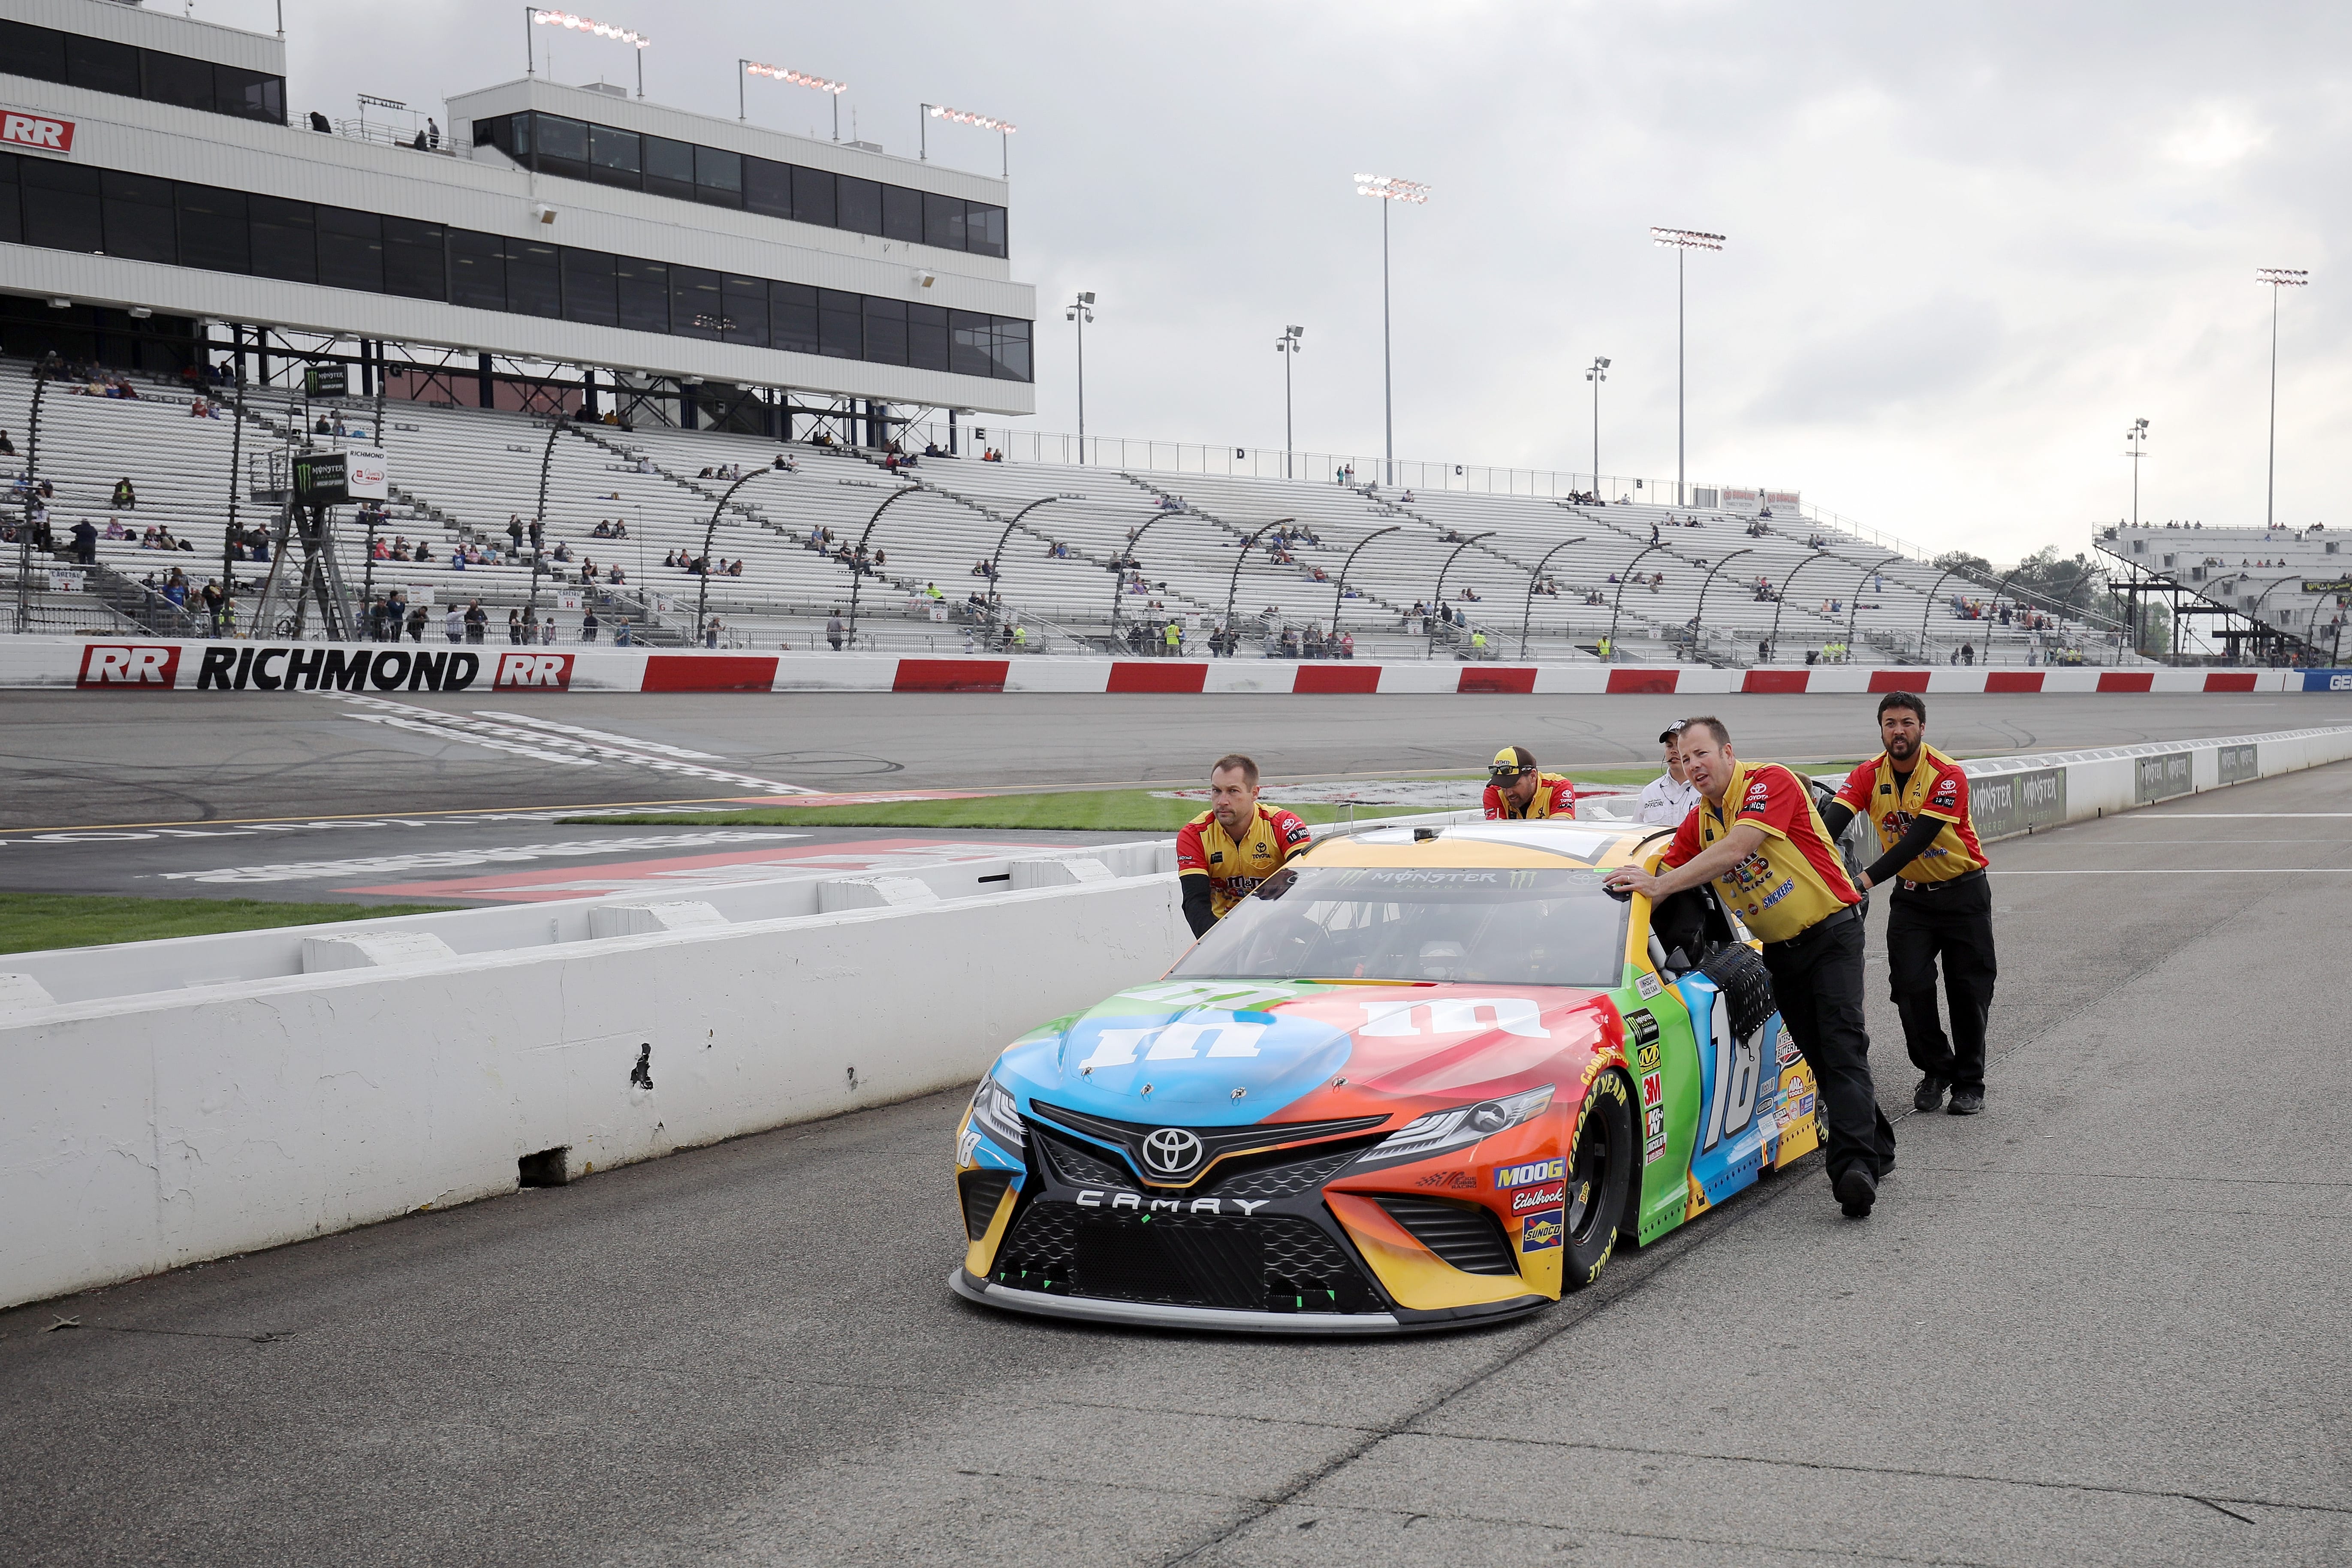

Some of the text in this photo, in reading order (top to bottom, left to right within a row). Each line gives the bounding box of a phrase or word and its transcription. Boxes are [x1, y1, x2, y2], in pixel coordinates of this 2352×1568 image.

[3, 115, 63, 147] RR
[388, 363, 404, 379] G
[976, 429, 985, 439] E
[350, 450, 384, 459] RICHMOND
[1237, 448, 1245, 459] D
[312, 464, 344, 473] MONSTER
[1456, 465, 1462, 475] C
[1636, 479, 1643, 488] B
[1724, 491, 1731, 501] GO
[1759, 489, 1764, 498] A
[1767, 494, 1775, 504] GO
[86, 647, 564, 691] RR RICHMOND RR
[2141, 757, 2186, 785] MONSTER MONSTER
[1973, 775, 2056, 817] MONSTER MONSTER
[1979, 820, 2006, 833] ENERGY
[1288, 833, 1297, 841] 18
[1371, 870, 1498, 883] MONSTER
[1763, 879, 1793, 908] SNICKERS
[1642, 987, 1651, 996] RACE
[1635, 1013, 1653, 1024] MONSTER
[1078, 1021, 1268, 1069] m
[1778, 1031, 1792, 1047] INTERS
[1580, 1046, 1630, 1086] GOODYEAR
[1643, 1073, 1661, 1106] 3M
[1789, 1077, 1803, 1092] MAC
[1789, 1089, 1803, 1098] TOOLS
[1774, 1107, 1786, 1120] LINCOLN
[1568, 1074, 1627, 1173] GOODYEAR
[956, 1129, 982, 1168] 18
[1647, 1137, 1663, 1154] LINCOLN
[1649, 1148, 1664, 1161] WELDERS
[1498, 1160, 1563, 1188] MOOG
[1076, 1190, 1270, 1215] CAMRY
[1513, 1187, 1564, 1210] Edelbrock
[1526, 1225, 1561, 1241] SUNOCO
[1587, 1226, 1617, 1283] EAGLE
